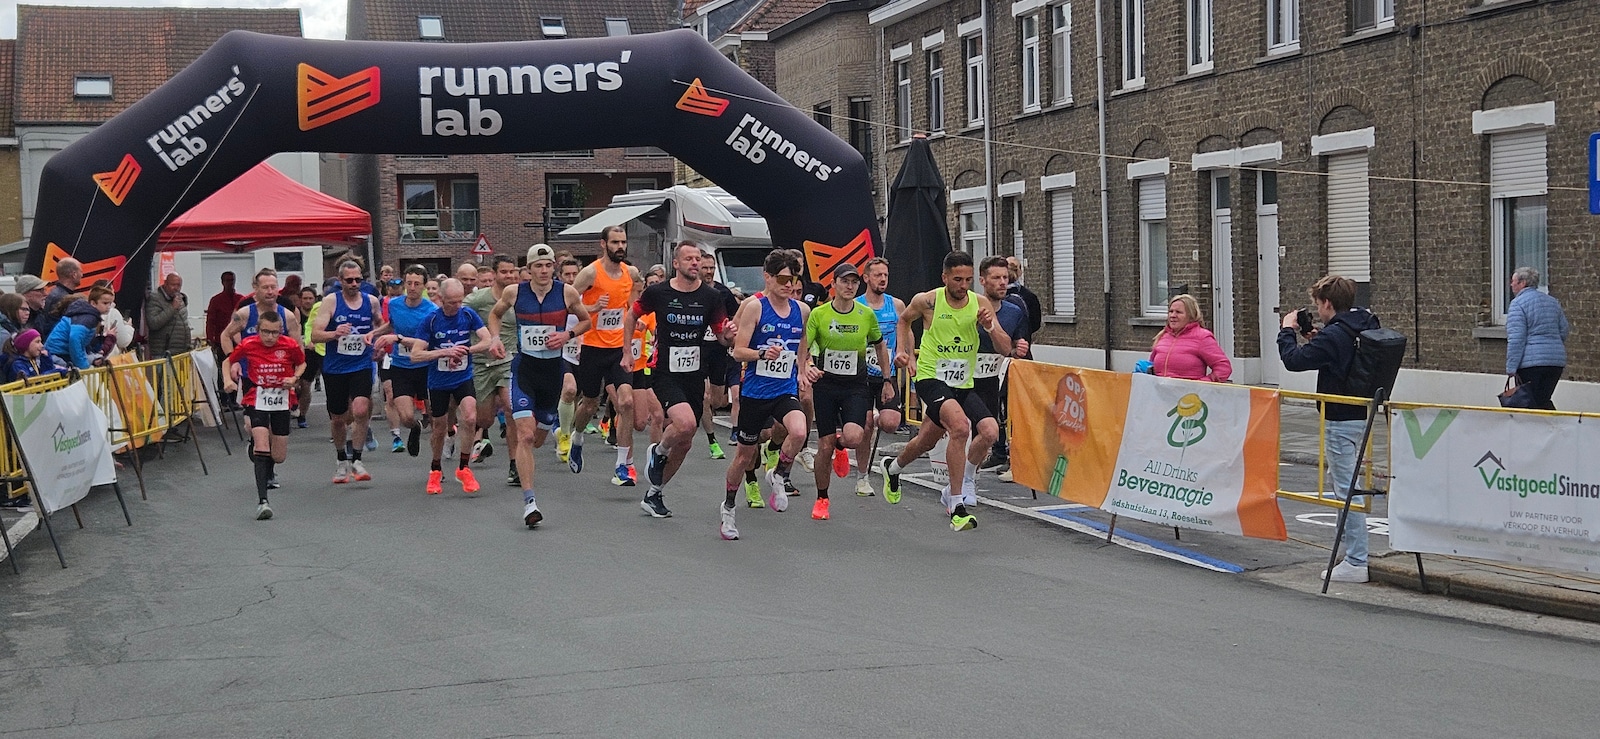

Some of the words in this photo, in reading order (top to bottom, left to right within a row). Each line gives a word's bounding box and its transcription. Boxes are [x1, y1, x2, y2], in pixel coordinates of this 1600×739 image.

[420, 97, 503, 136] lab
[725, 126, 766, 164] lab
[158, 136, 208, 171] lab
[343, 342, 362, 351] 1632
[937, 343, 974, 353] SKYLUX
[677, 356, 695, 368] 1757
[764, 360, 788, 373] 1620
[829, 359, 851, 370] 1676
[943, 370, 965, 381] 1746
[263, 396, 283, 406] 1644
[1143, 460, 1162, 475] All
[1163, 463, 1199, 483] Drinks
[1117, 468, 1214, 507] Bevernagie
[1171, 511, 1213, 526] Roeselare
[1509, 510, 1523, 519] UW
[1525, 512, 1559, 522] PARTNER
[1560, 515, 1583, 525] VOOR
[1503, 521, 1539, 532] VERKOOP
[1541, 525, 1551, 533] EN
[1553, 527, 1590, 538] VERHUUR
